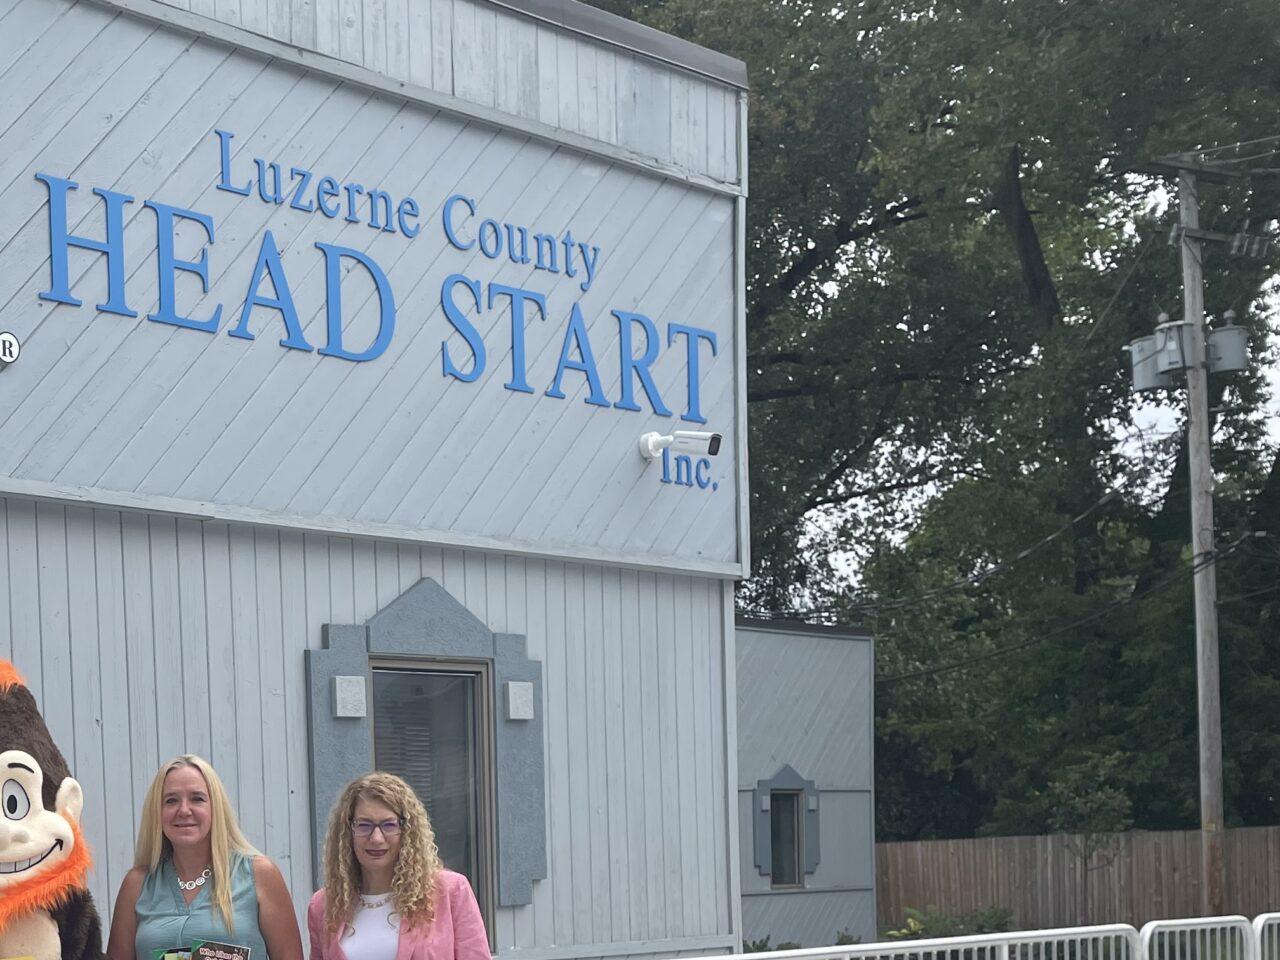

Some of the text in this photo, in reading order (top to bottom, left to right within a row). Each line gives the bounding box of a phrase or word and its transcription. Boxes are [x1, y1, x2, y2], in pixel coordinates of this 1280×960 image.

[36, 172, 718, 424] HEAD START
[215, 128, 601, 291] Luzerne County
